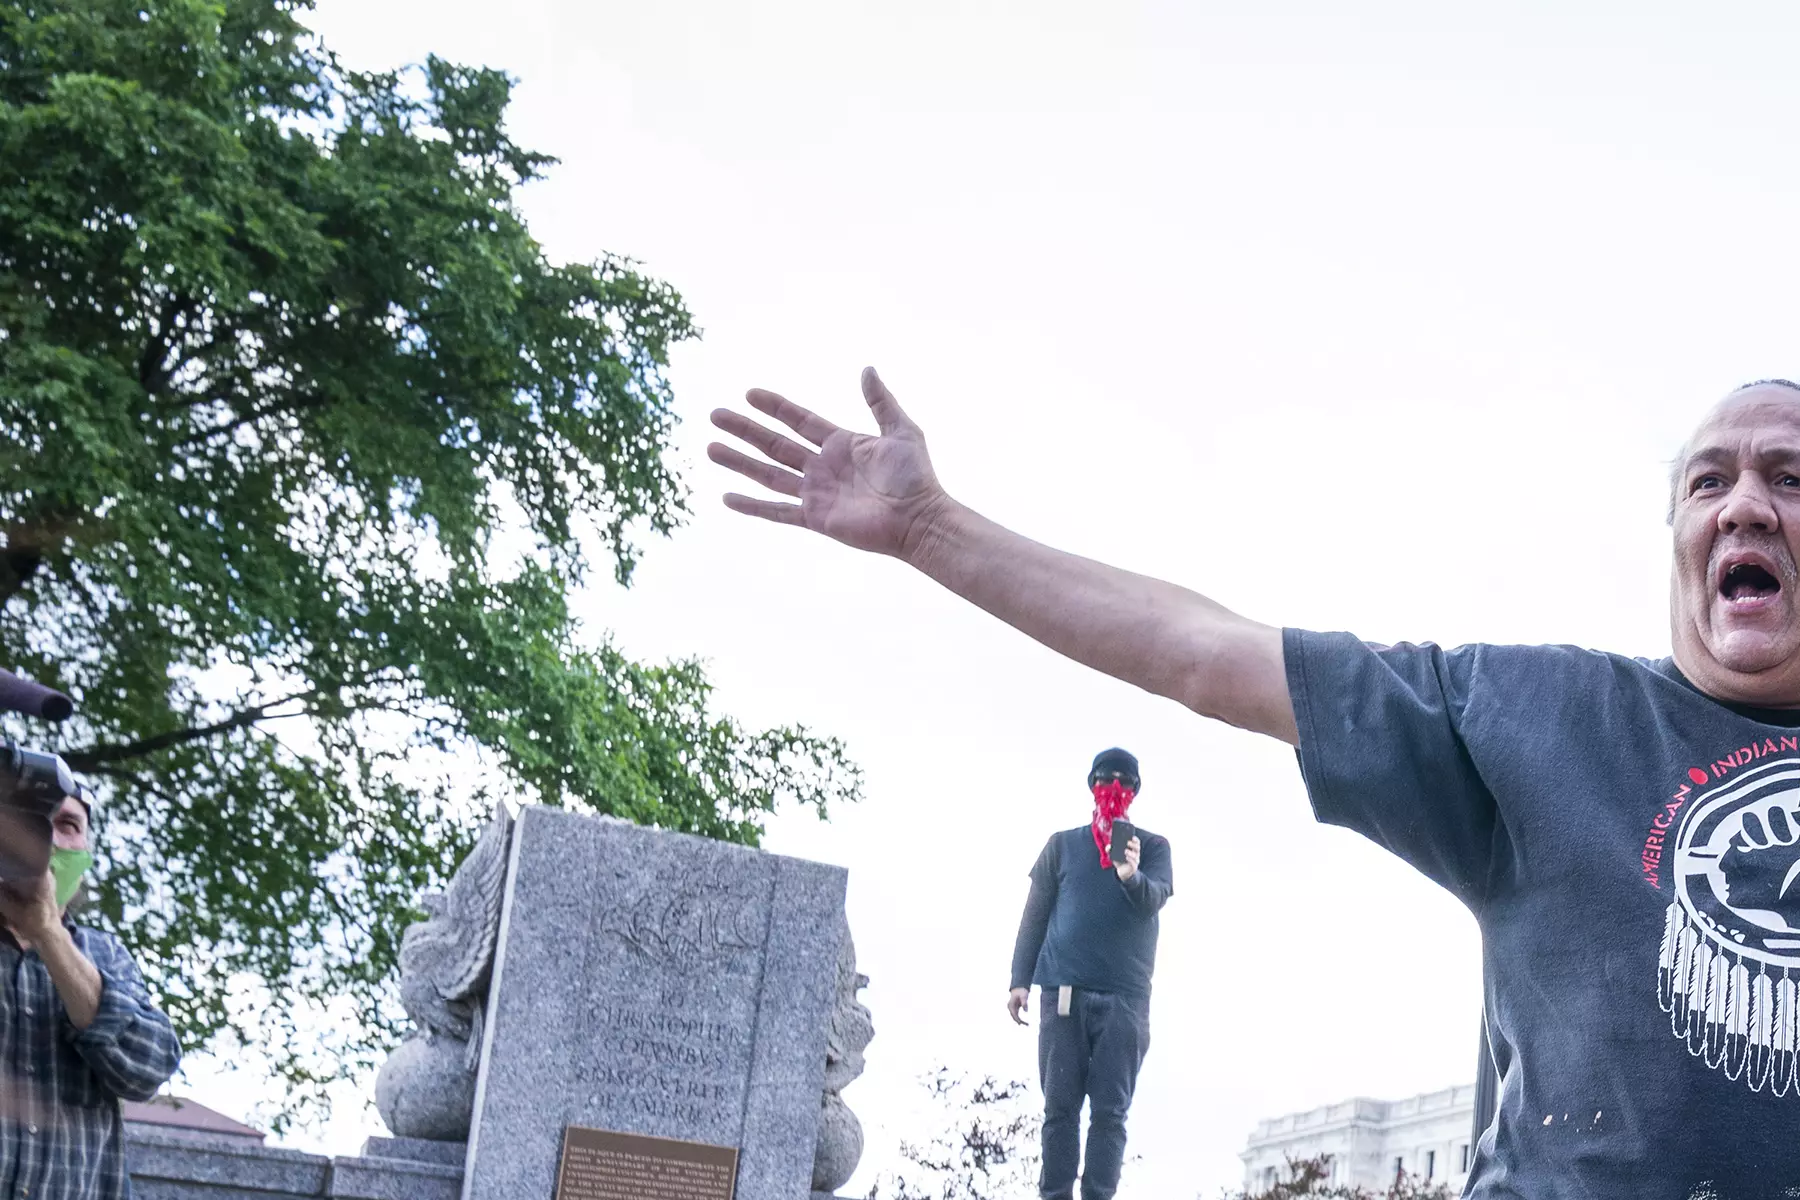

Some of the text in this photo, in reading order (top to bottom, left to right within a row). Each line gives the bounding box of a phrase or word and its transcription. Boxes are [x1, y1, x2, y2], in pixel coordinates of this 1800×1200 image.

[1642, 784, 1691, 889] AMERICAN
[1711, 736, 1799, 780] INDIAN
[588, 1005, 742, 1047] CHRISTOPHER
